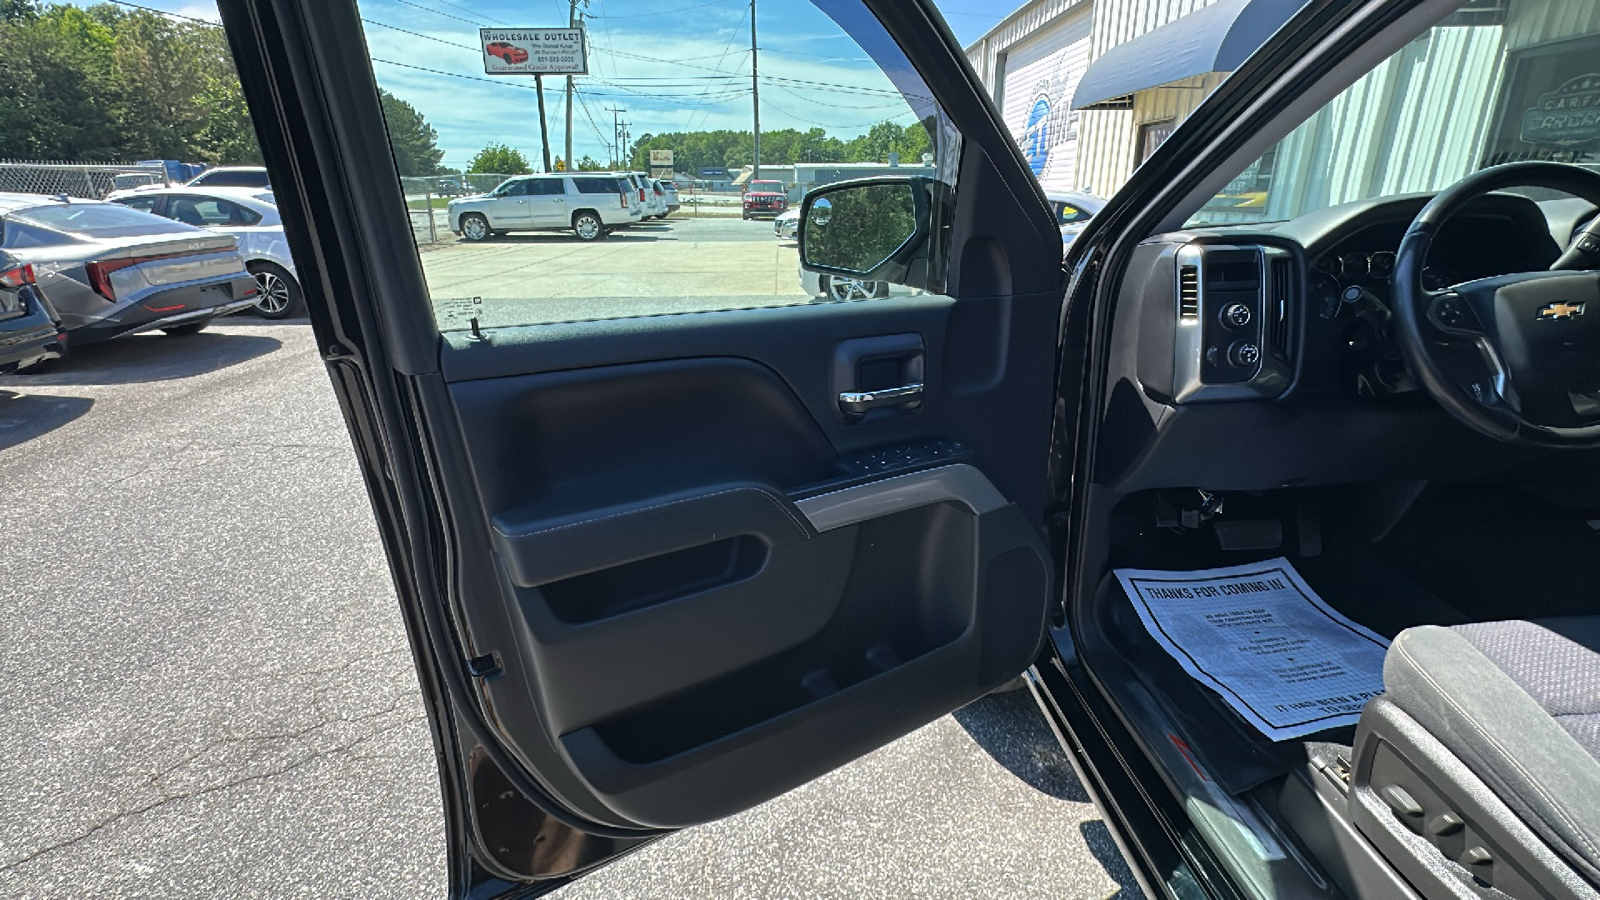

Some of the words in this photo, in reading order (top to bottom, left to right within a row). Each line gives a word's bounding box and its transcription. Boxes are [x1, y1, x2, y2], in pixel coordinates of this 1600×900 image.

[484, 33, 541, 41] WHOLESALE
[544, 33, 580, 41] OUTLET
[1144, 586, 1194, 599] THANKS
[1193, 586, 1222, 598] FOR
[1219, 580, 1270, 595] COMING
[1274, 704, 1289, 712] IT
[1288, 701, 1317, 710] HAS
[1315, 696, 1351, 705] BEEN
[1348, 694, 1361, 702] A
[1318, 706, 1341, 714] TO
